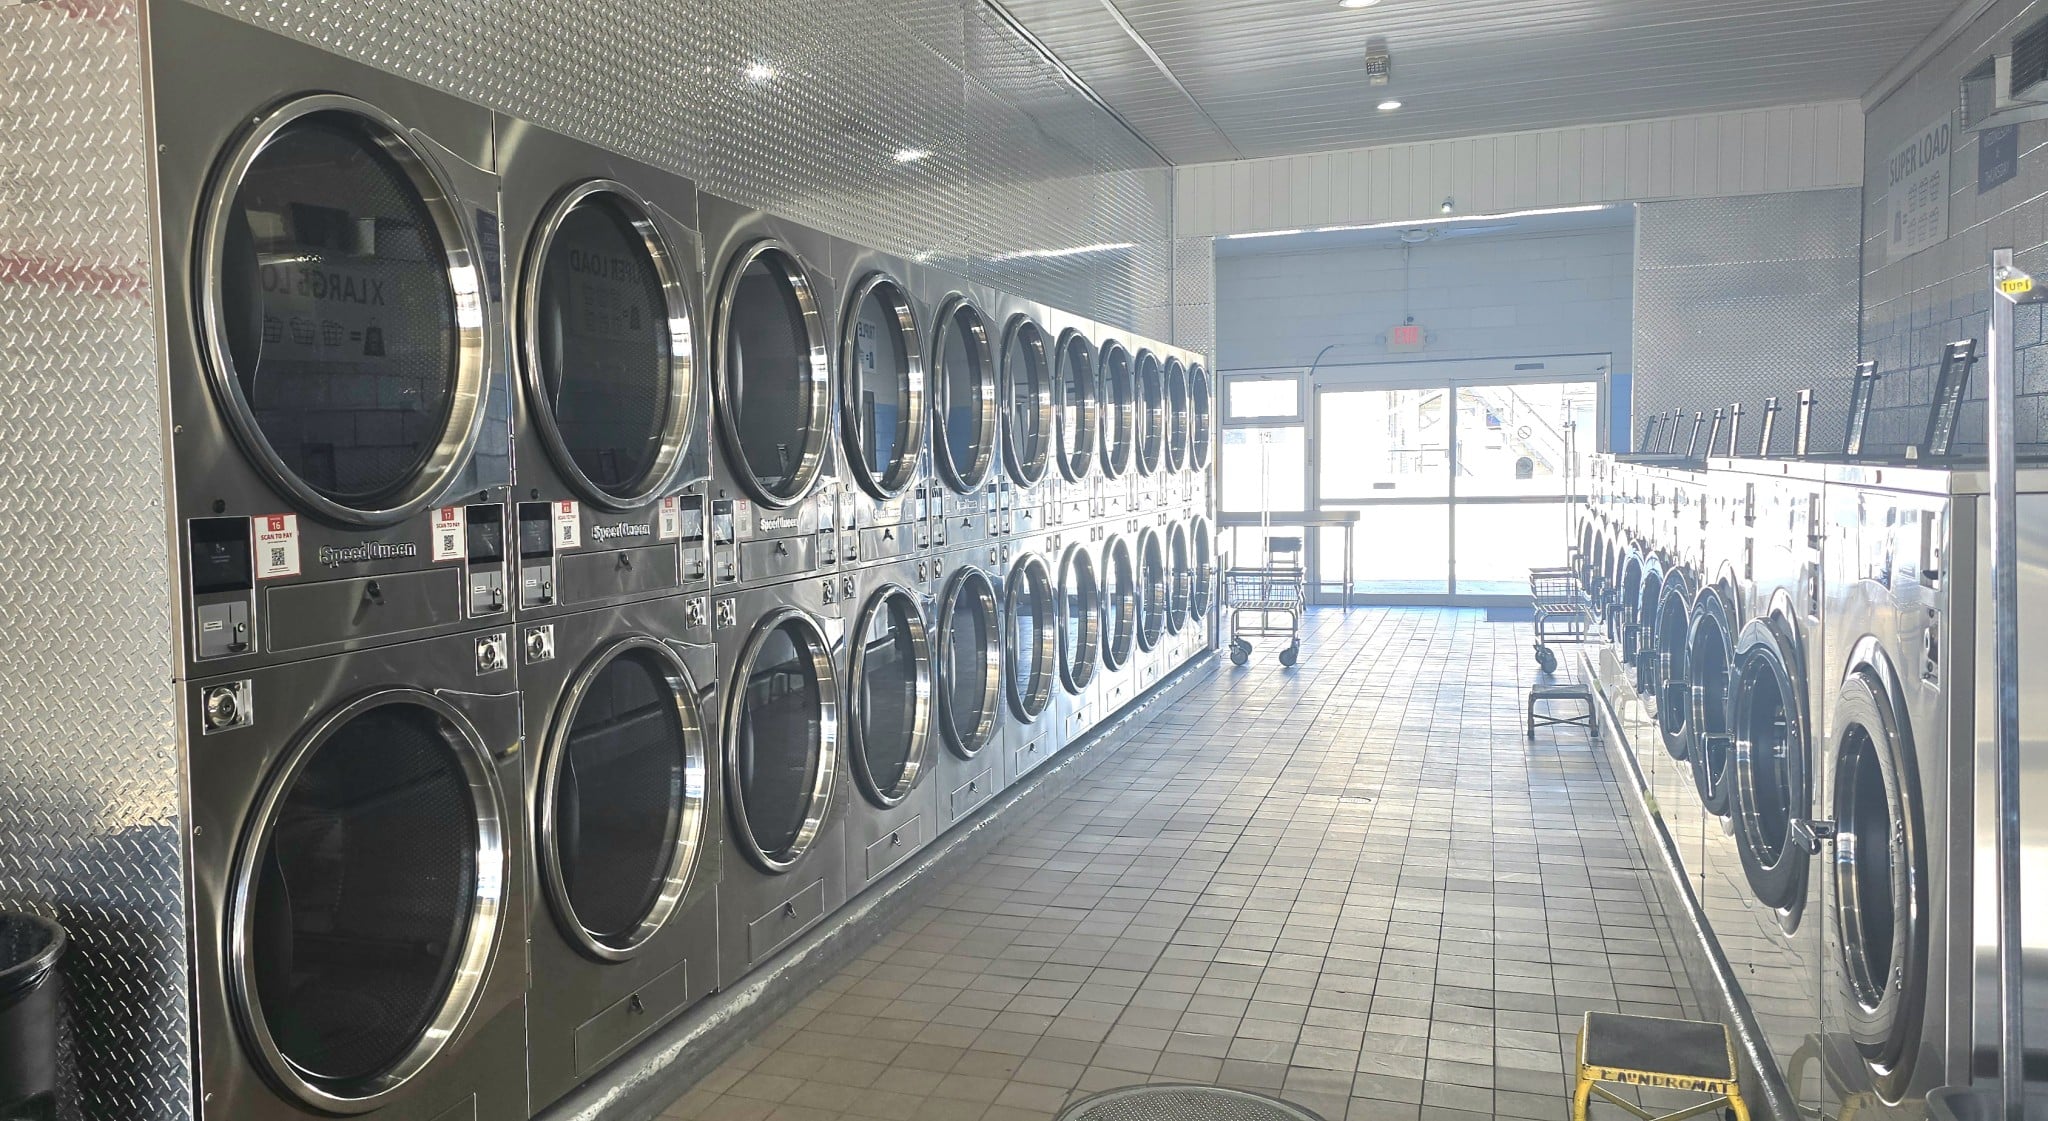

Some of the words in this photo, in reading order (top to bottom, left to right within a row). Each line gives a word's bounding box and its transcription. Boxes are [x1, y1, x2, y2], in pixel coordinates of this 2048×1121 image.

[1890, 144, 1916, 186] SUPER
[1919, 124, 1949, 168] LOAD
[1394, 327, 1418, 345] EXIT
[272, 521, 281, 530] 16
[1600, 1069, 1728, 1094] LAUNDROMAT
